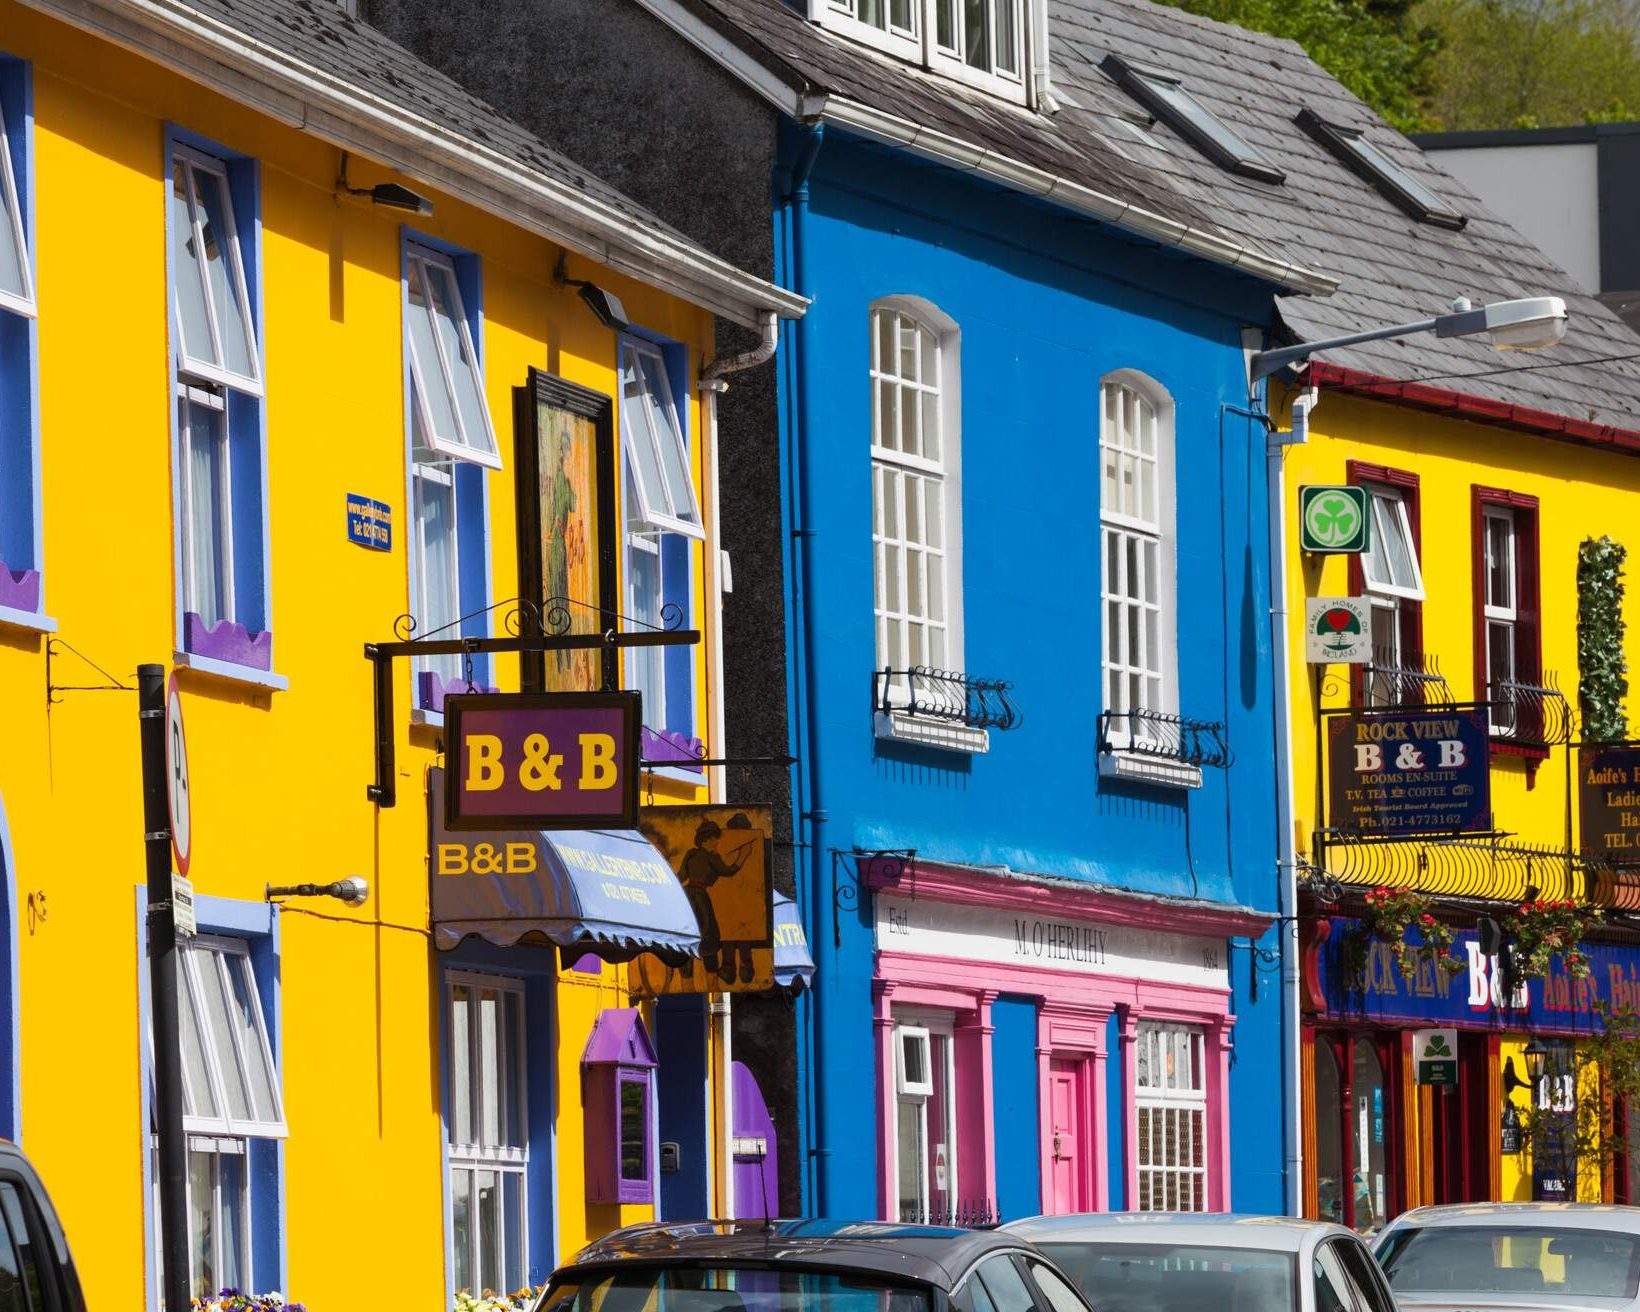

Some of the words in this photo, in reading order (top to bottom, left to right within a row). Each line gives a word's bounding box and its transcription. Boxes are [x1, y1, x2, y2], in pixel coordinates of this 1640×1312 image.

[1333, 600, 1363, 617] HOMES
[1356, 721, 1409, 742] ROCK
[1411, 719, 1460, 740] VIEW
[466, 735, 504, 791] B
[519, 733, 563, 791] &
[579, 733, 617, 790] B
[1354, 743, 1382, 772] B
[1396, 742, 1424, 770] &
[1437, 740, 1466, 768] B
[1361, 773, 1403, 786] ROOMS
[1587, 767, 1627, 785] Aoife's
[1368, 788, 1388, 800] TEA
[1408, 786, 1447, 798] COFFEE
[1604, 833, 1633, 849] TEL.
[437, 842, 537, 875] B&B
